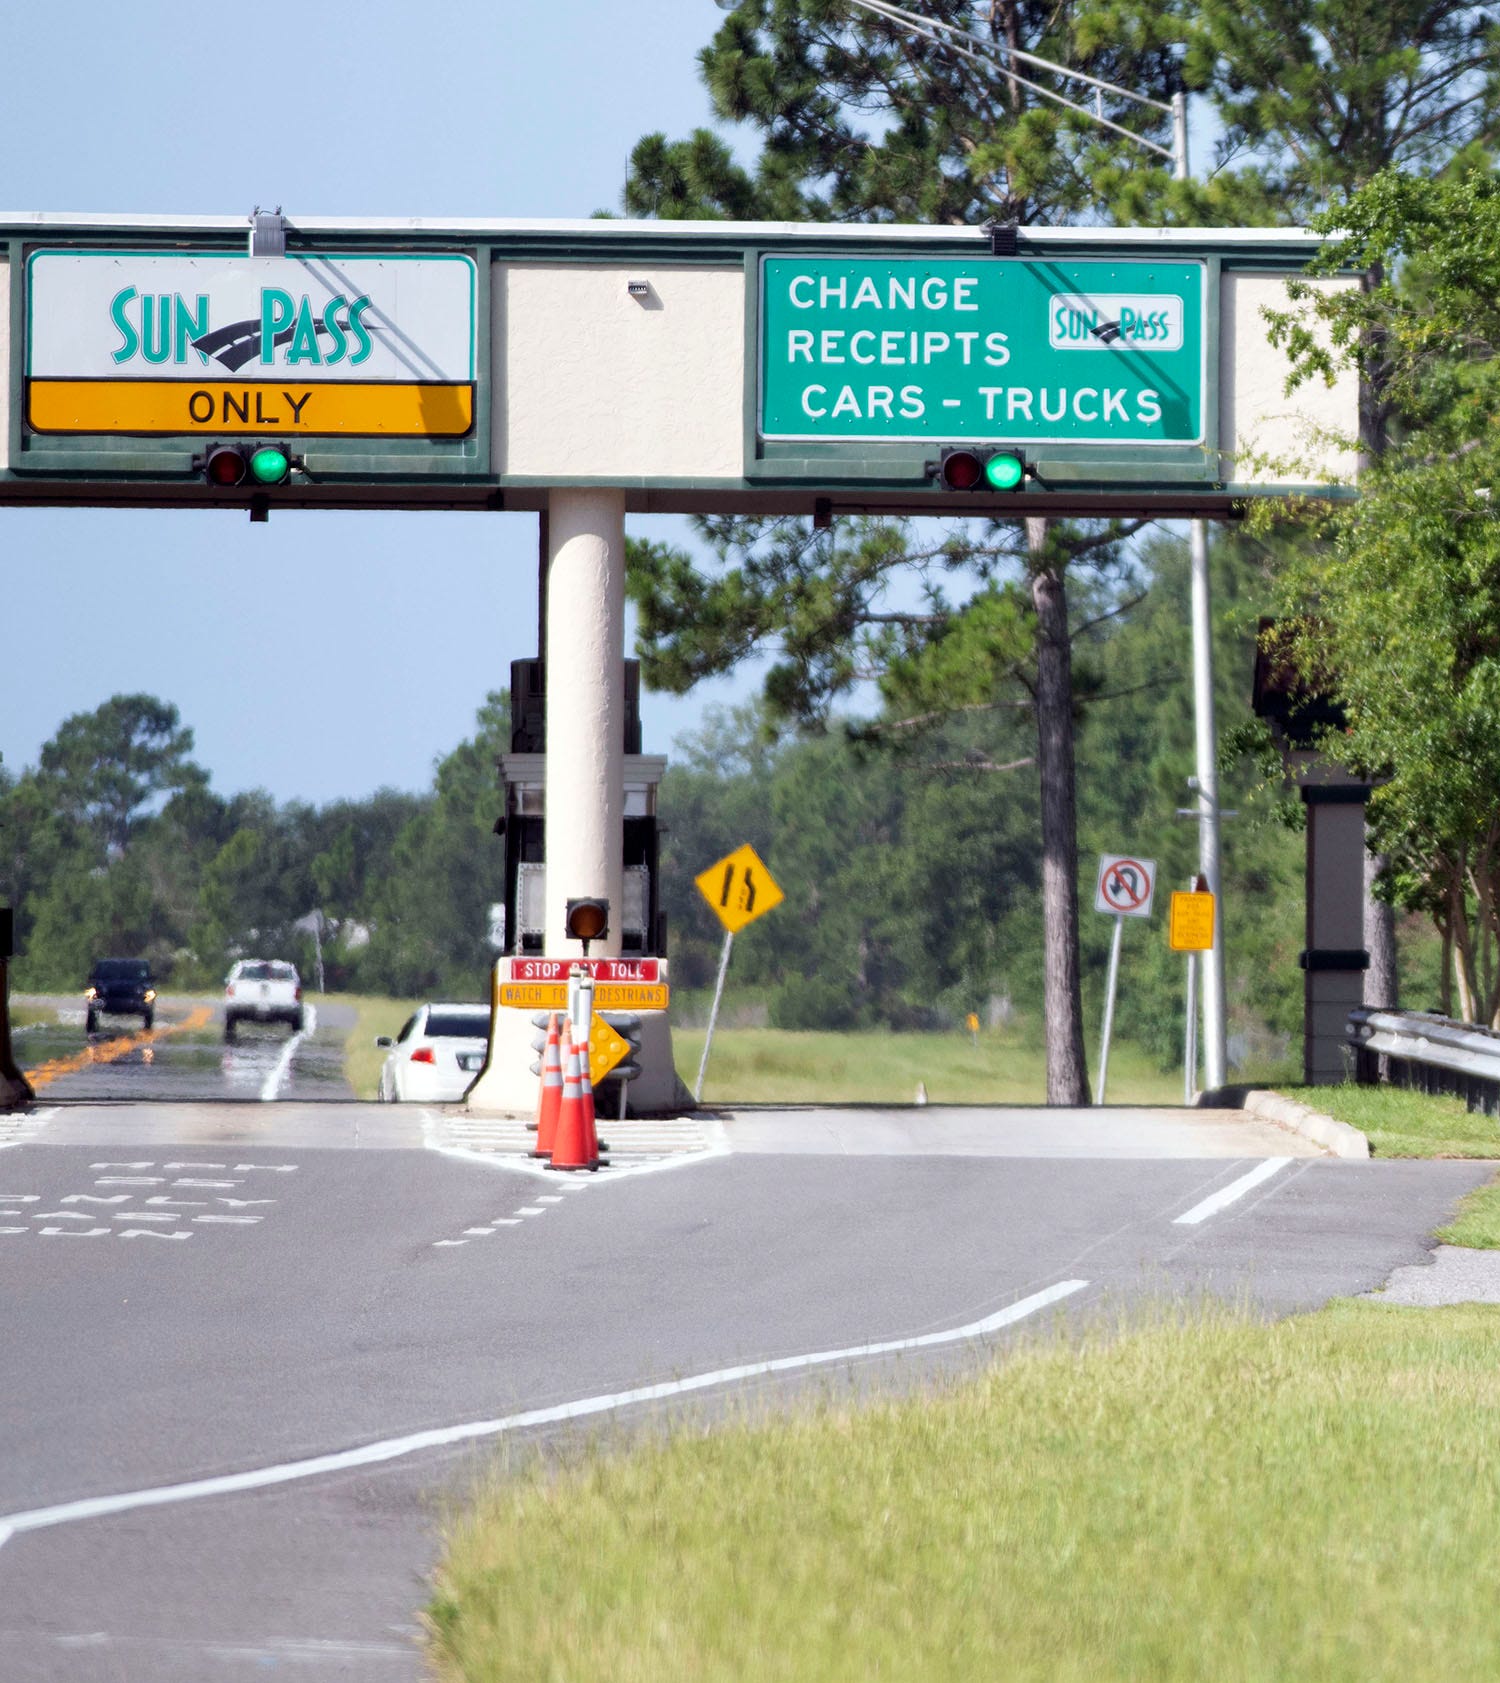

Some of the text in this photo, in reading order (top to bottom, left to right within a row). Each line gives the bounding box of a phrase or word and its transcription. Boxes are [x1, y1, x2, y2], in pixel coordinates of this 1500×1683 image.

[788, 275, 979, 311] CHANGE
[110, 284, 373, 367] SUN PASS
[1055, 307, 1169, 341] SUN PASS
[788, 329, 1011, 366] RECEIPTS
[188, 391, 313, 424] ONLY
[801, 384, 926, 419] CARS
[978, 387, 1162, 422] TRUCKS
[525, 962, 561, 977] STOP
[610, 962, 644, 978] TOLL
[506, 987, 542, 1001] WATCH
